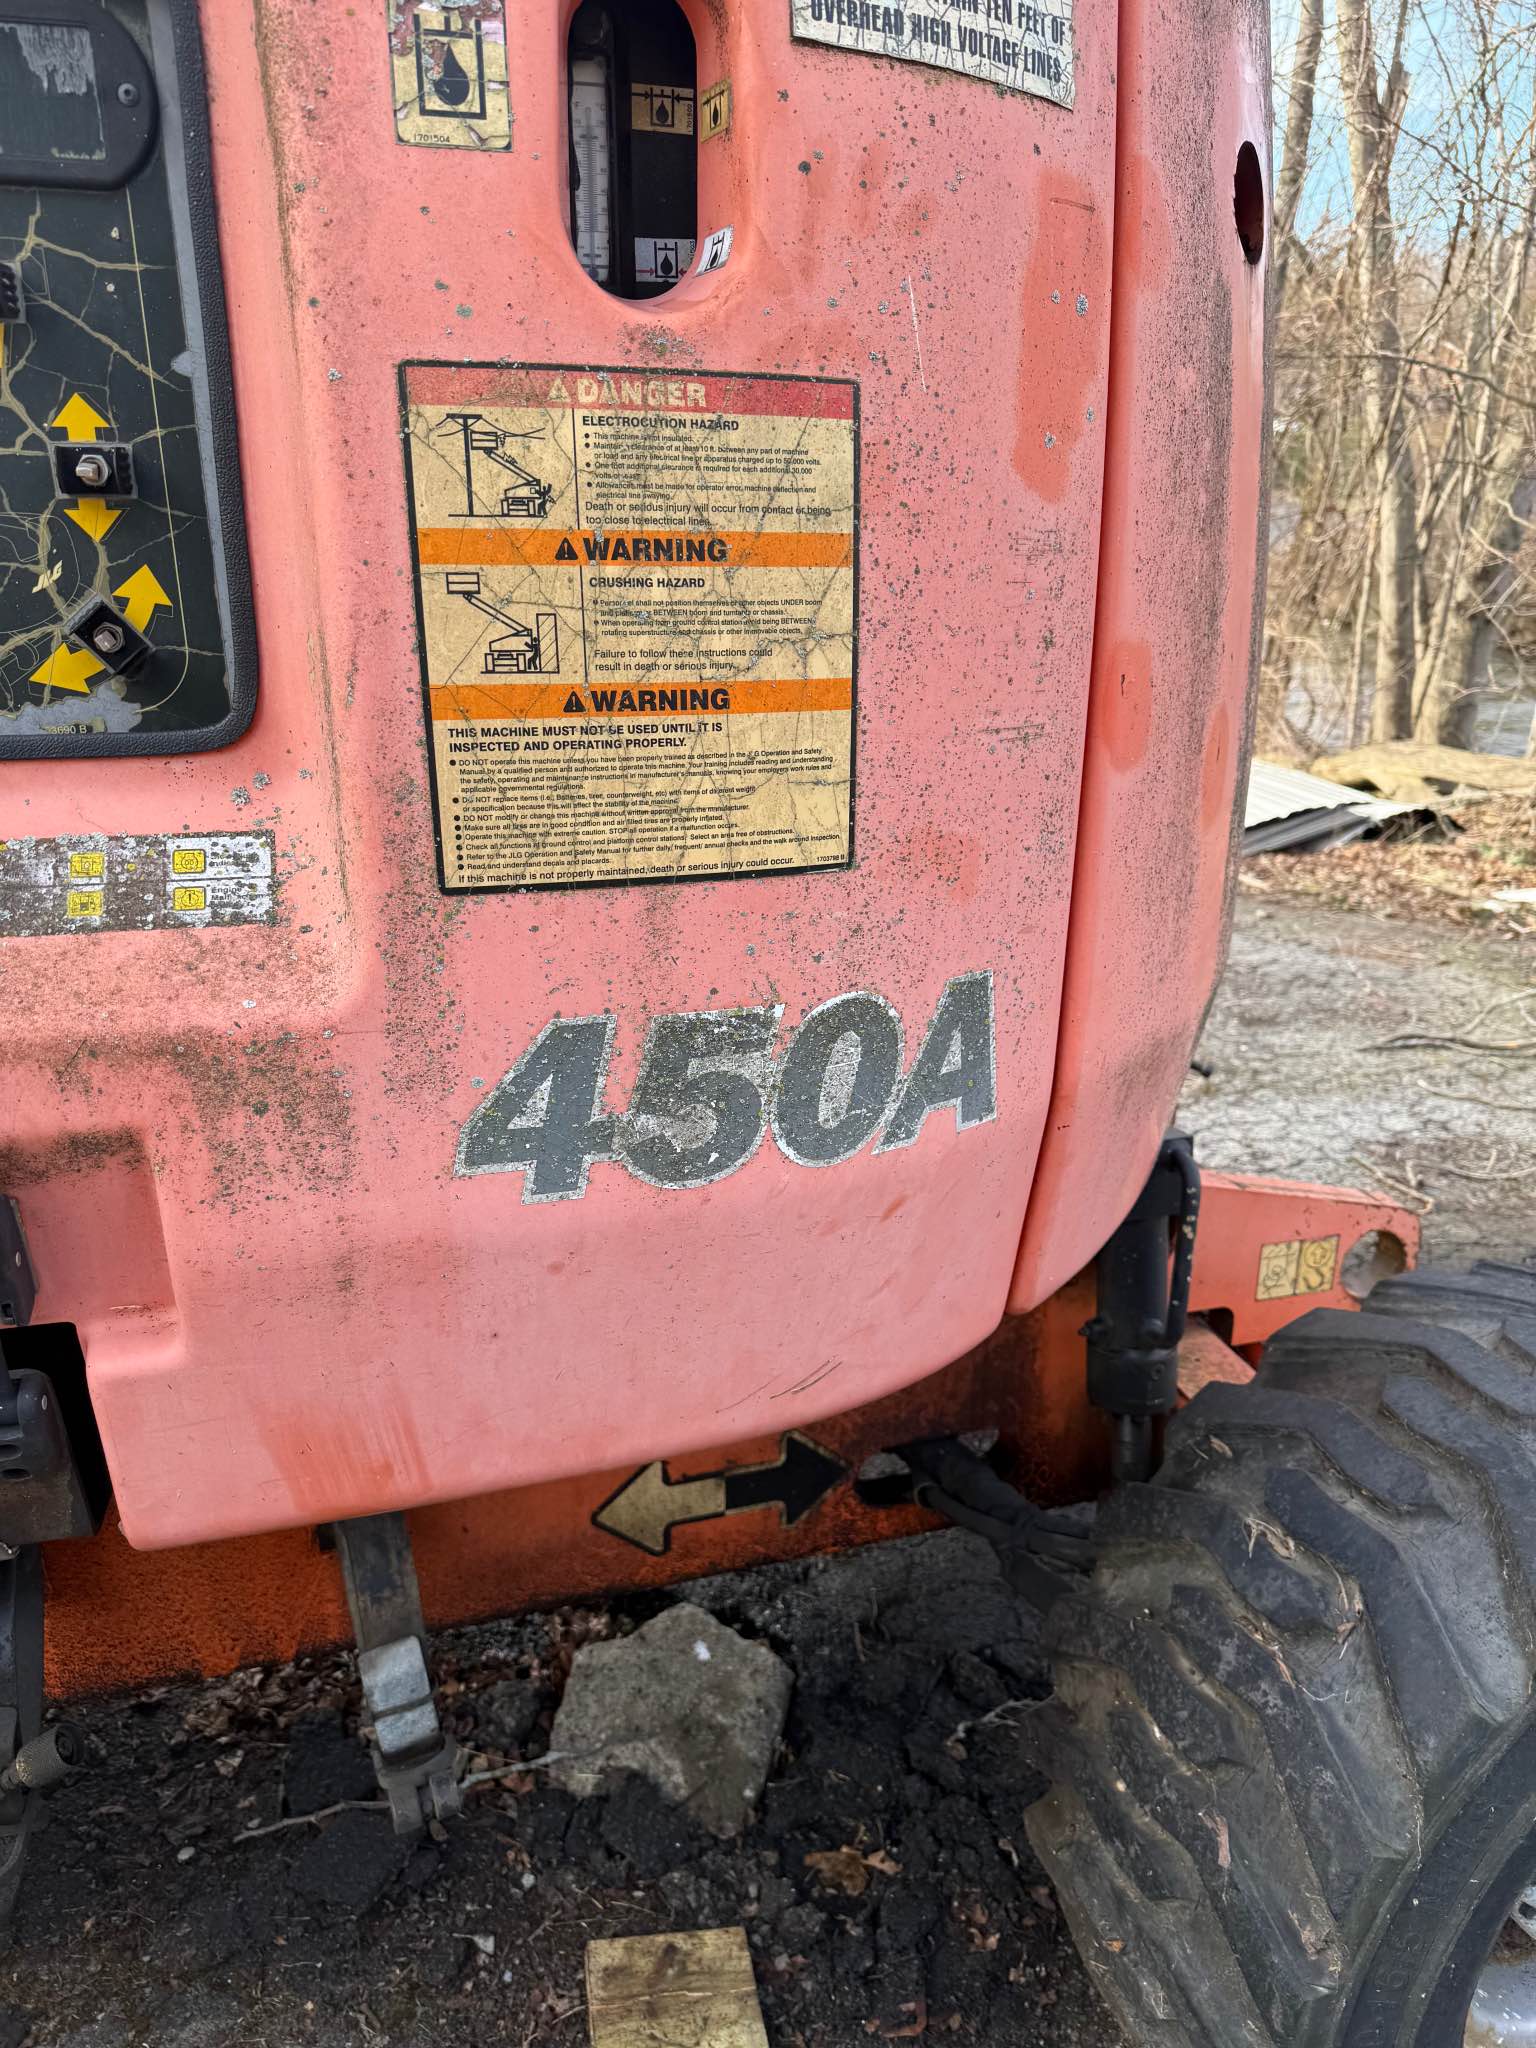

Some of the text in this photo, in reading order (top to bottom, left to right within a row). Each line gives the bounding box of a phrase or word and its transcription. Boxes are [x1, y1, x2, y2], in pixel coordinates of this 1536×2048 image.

[1018, 3, 1045, 38] FEET
[1051, 16, 1065, 46] OF
[811, 0, 904, 36] OVERHEAD
[912, 13, 951, 48] HIGH
[958, 22, 1019, 68] VOLTAGE
[576, 379, 706, 408] DANGER
[582, 416, 739, 430] ELECTROCUTION HAZARD
[586, 502, 613, 510] Death
[628, 503, 664, 512] serious
[666, 504, 691, 513] injury
[694, 504, 709, 512] will
[739, 504, 760, 512] from
[762, 506, 794, 514] contact
[807, 506, 831, 516] being
[644, 517, 686, 525] electrical
[584, 538, 728, 562] WARNING
[31, 559, 63, 594] JLG
[590, 578, 705, 588] CRUSHING HAZARD
[594, 650, 625, 658] Failure
[640, 650, 667, 658] follow
[668, 649, 693, 658] these
[696, 648, 746, 657] instructions
[748, 648, 772, 656] could
[595, 662, 621, 670] result
[635, 662, 660, 670] death
[709, 662, 736, 670] injury.
[592, 688, 730, 712] WARNING
[80, 724, 87, 734] B
[448, 722, 722, 738] THIS MACHINE MUST NOT BE USED UNTIL IT IS
[450, 738, 686, 752] INSPECTED AND OPERATING PROPERLY.
[760, 750, 790, 758] Operation
[524, 851, 558, 859] Operation
[459, 875, 464, 883] If
[468, 874, 484, 882] this
[488, 872, 526, 881] machine
[557, 869, 594, 880] properly
[597, 867, 648, 877] maintained,
[650, 865, 674, 873] death
[688, 862, 718, 872] serious
[721, 860, 744, 870] injury
[746, 859, 768, 867] could
[770, 857, 794, 865] occur.
[453, 970, 998, 1205] 450A
